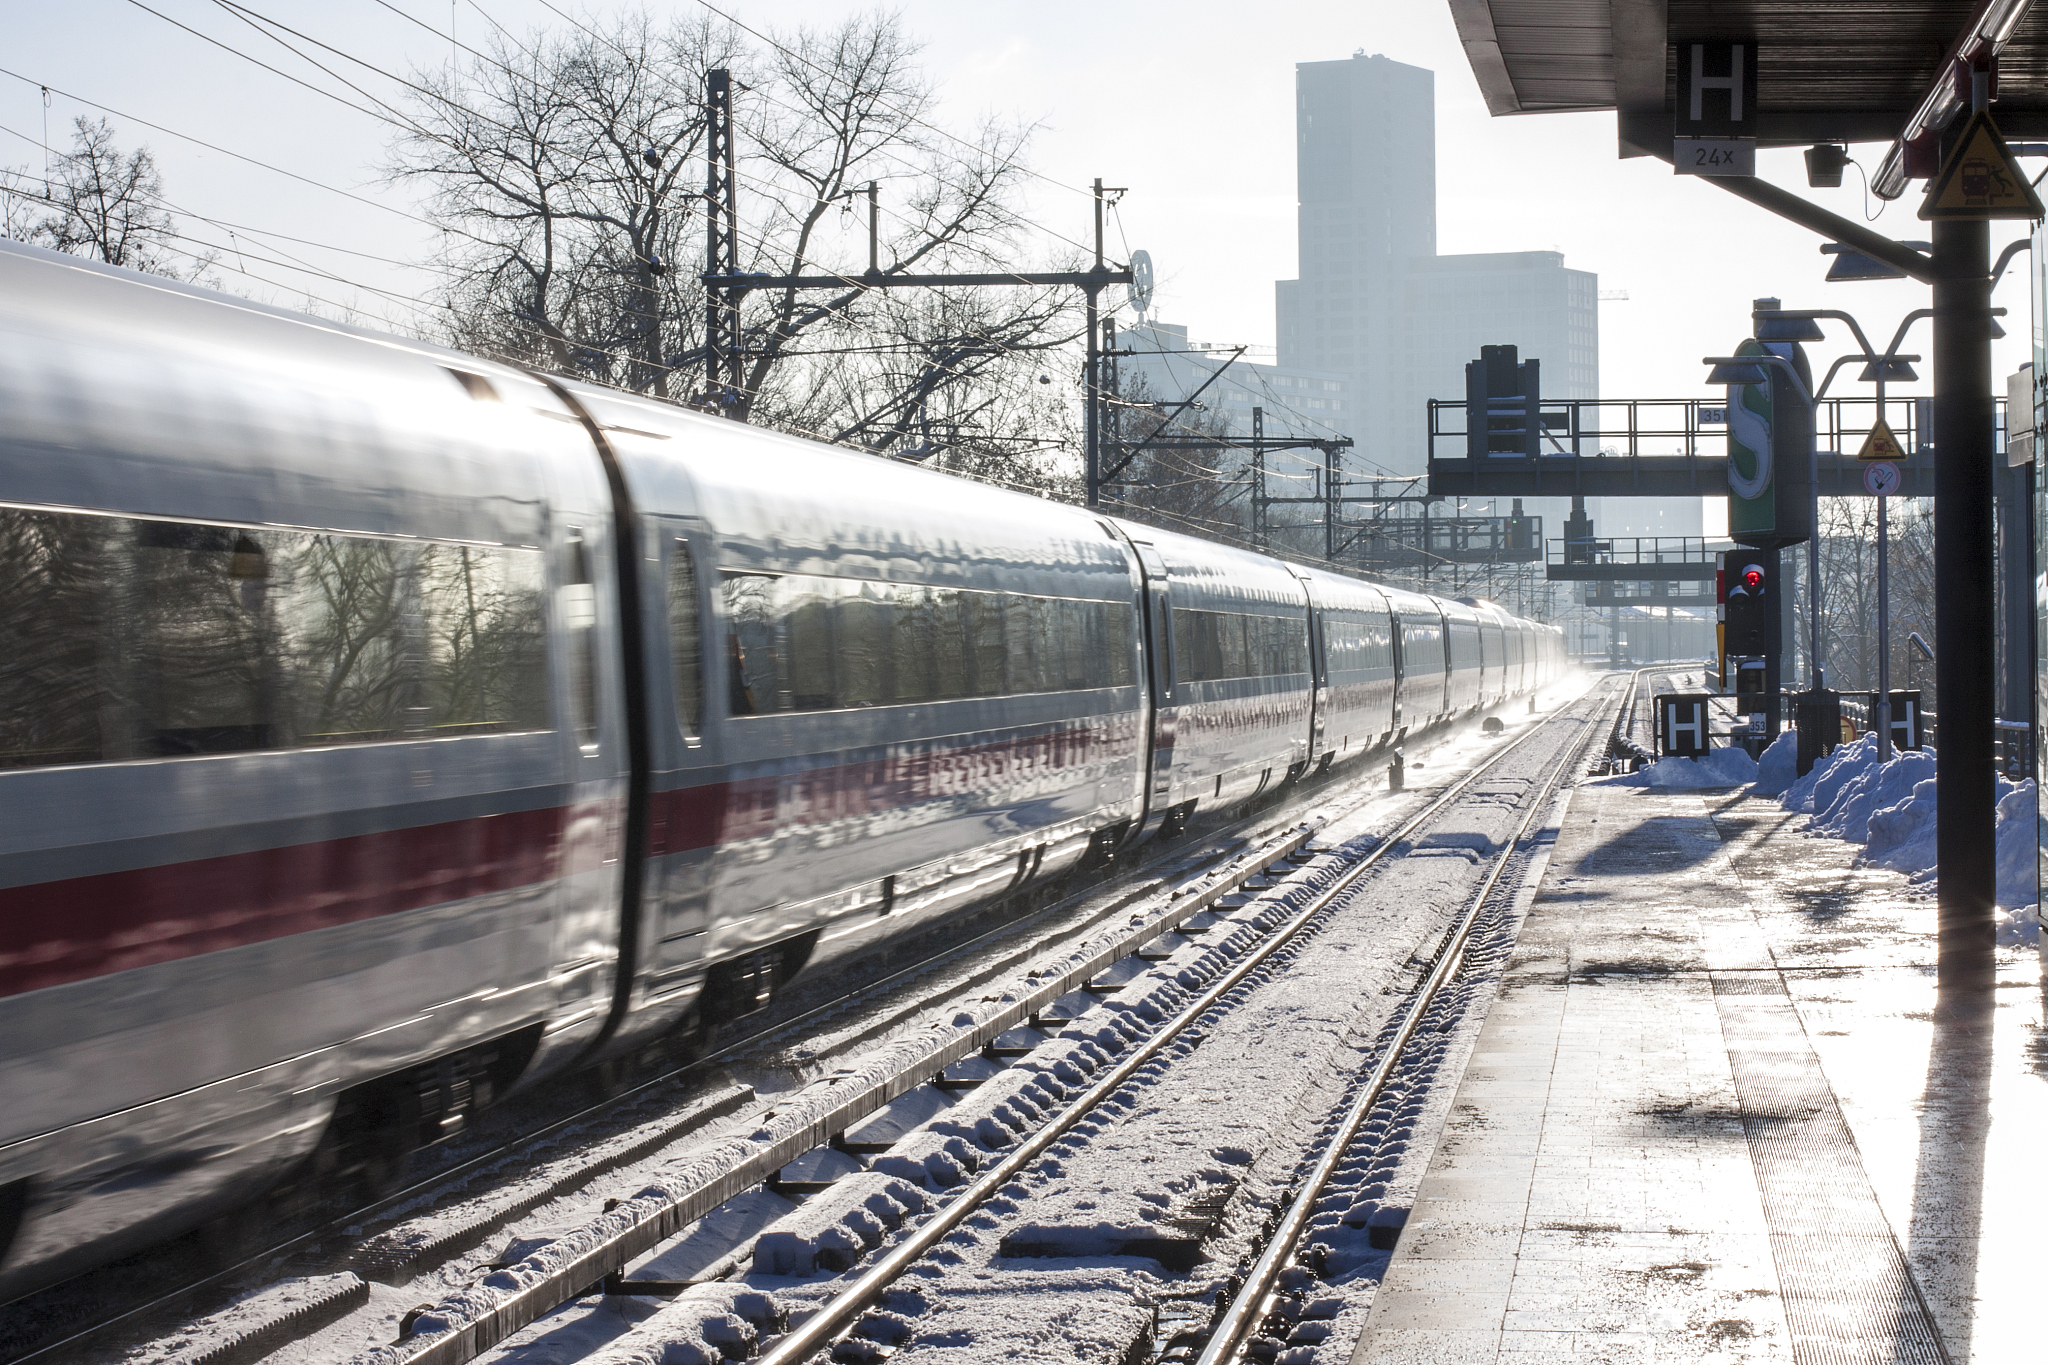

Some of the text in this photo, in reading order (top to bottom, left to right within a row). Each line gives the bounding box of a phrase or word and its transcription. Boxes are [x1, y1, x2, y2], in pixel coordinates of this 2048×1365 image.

[1690, 44, 1744, 121] H
[1703, 409, 1726, 422] 351
[1727, 363, 1771, 500] S
[1668, 703, 1702, 750] H
[1750, 721, 1766, 732] 353
